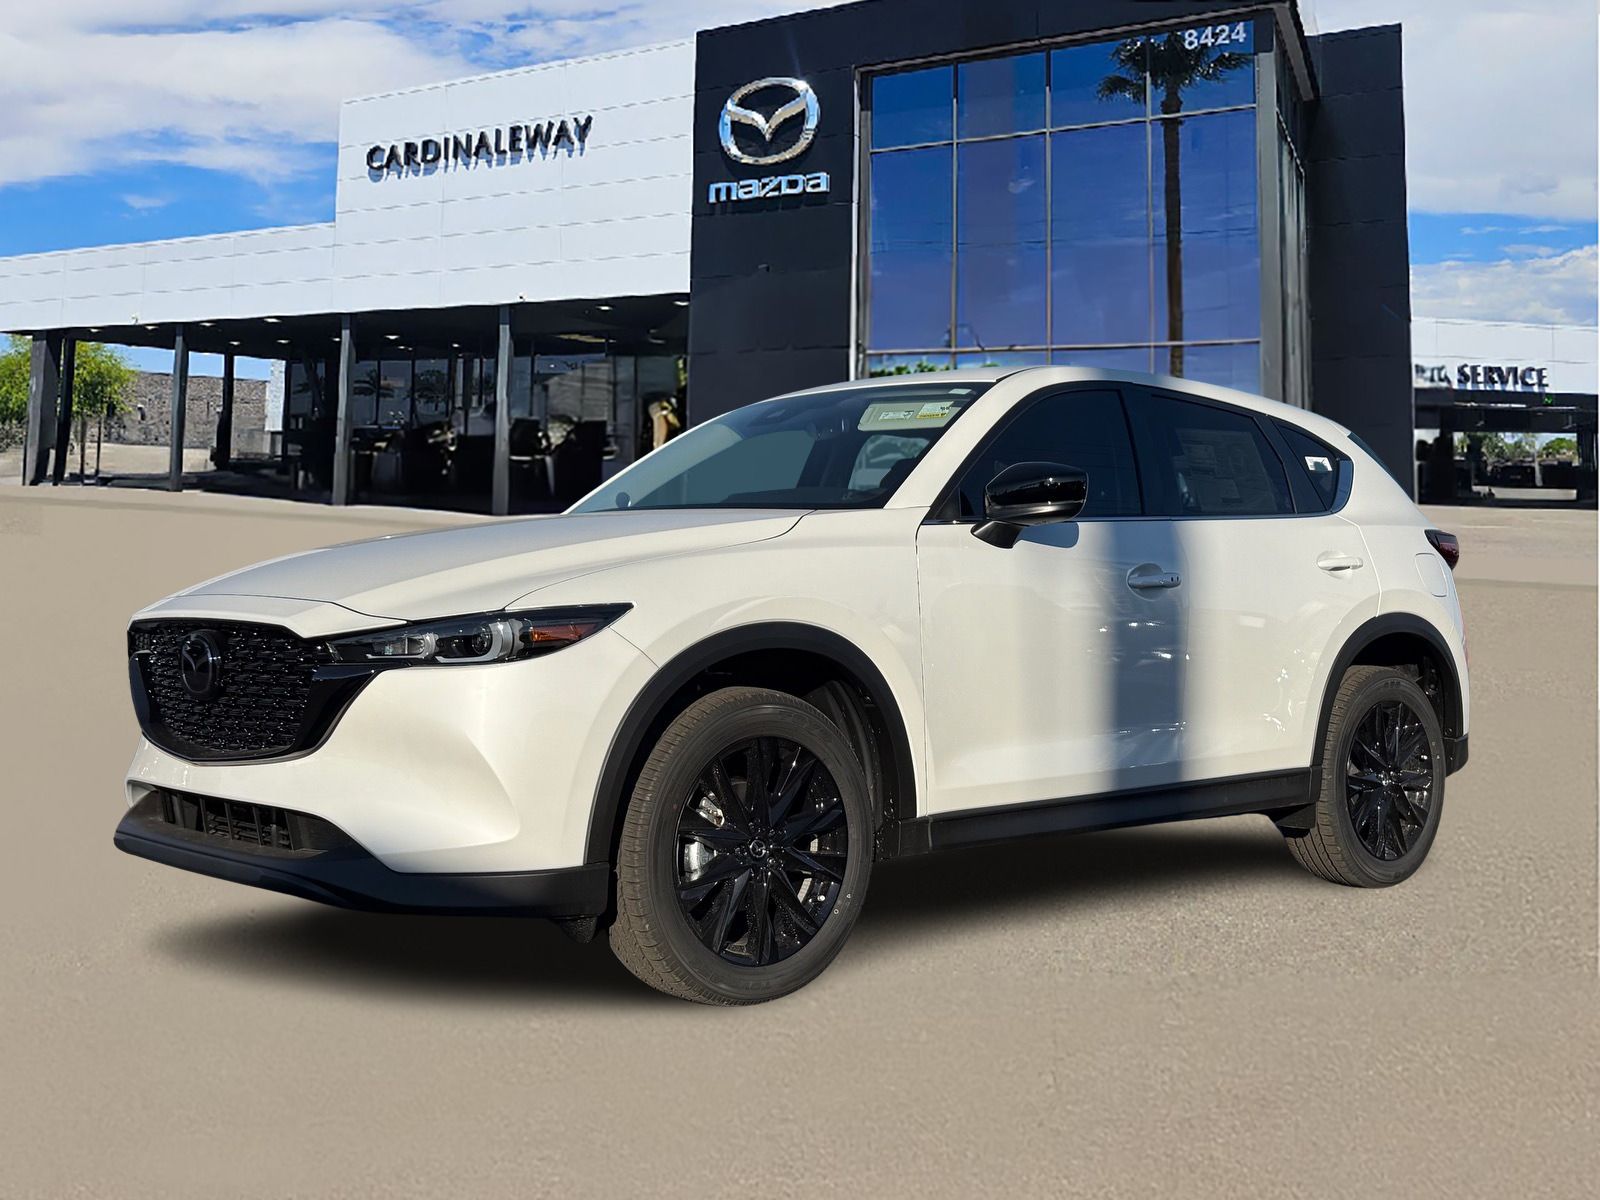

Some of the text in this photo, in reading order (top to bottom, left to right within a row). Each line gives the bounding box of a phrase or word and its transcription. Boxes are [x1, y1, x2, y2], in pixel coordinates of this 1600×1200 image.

[1184, 22, 1246, 50] 8424
[366, 116, 592, 171] CARDINALEWAY
[709, 171, 830, 203] mazda
[1457, 363, 1549, 387] SERVICE
